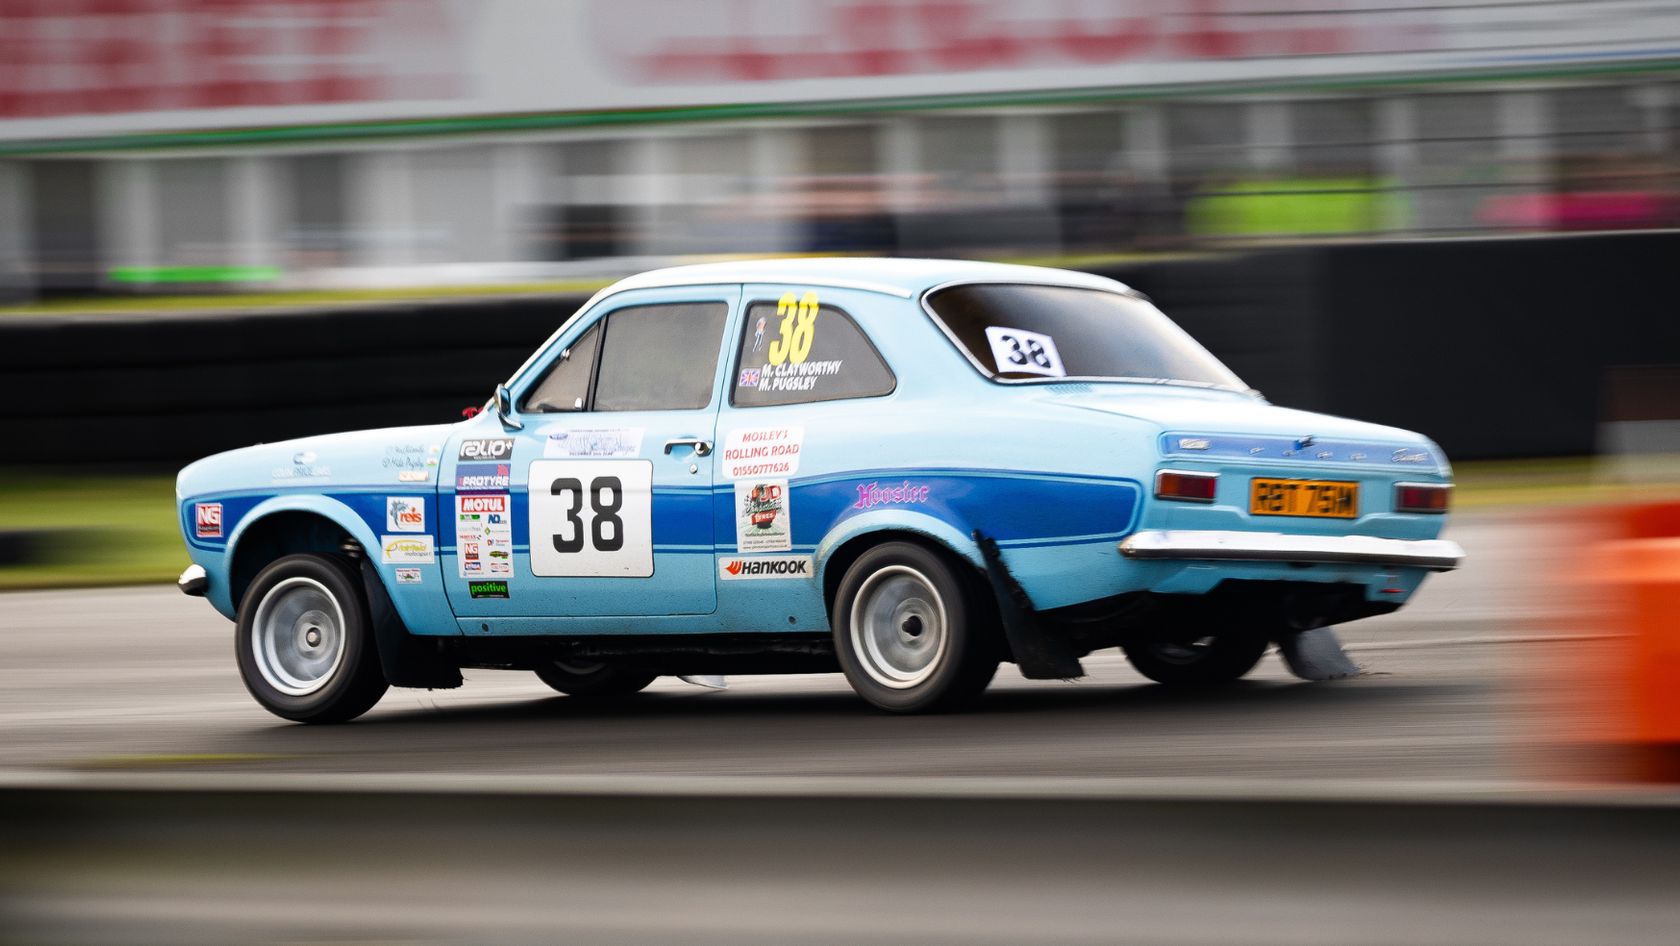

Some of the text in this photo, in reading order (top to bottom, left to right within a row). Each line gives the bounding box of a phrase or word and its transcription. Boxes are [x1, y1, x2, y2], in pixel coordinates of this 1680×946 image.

[769, 292, 819, 366] 38
[1002, 335, 1051, 368] 38
[761, 363, 774, 377] M.
[758, 377, 818, 391] M. PUGSLEY
[725, 444, 799, 460] ROLLING ROAD
[463, 475, 509, 487] PROTYRE
[463, 498, 504, 511] MOTUL
[198, 506, 220, 525] NG
[400, 507, 422, 522] reis
[551, 476, 624, 553] 38
[471, 582, 506, 594] positive
